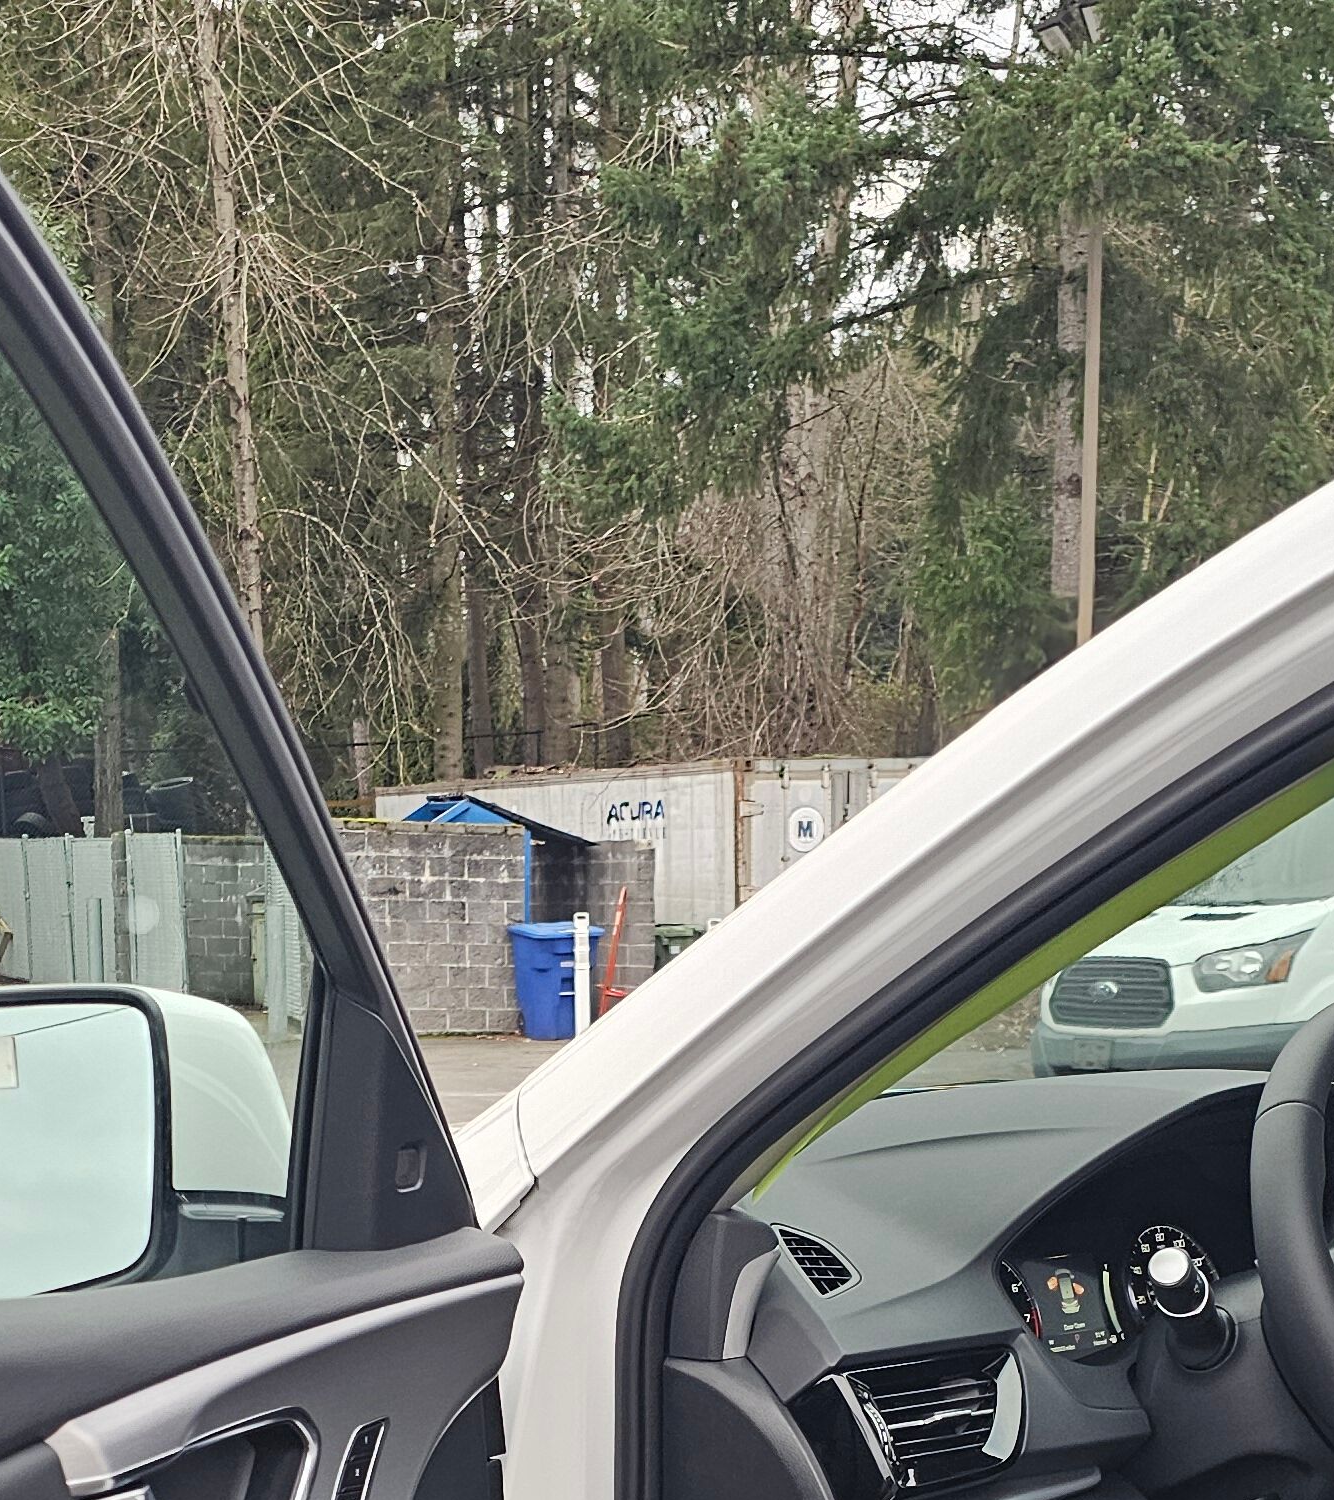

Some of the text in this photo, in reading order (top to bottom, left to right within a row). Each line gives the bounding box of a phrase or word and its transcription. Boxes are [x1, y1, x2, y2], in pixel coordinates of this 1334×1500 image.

[606, 799, 665, 825] ACURA
[798, 820, 815, 839] M
[1011, 1281, 1019, 1293] 6
[1023, 1313, 1031, 1323] 7
